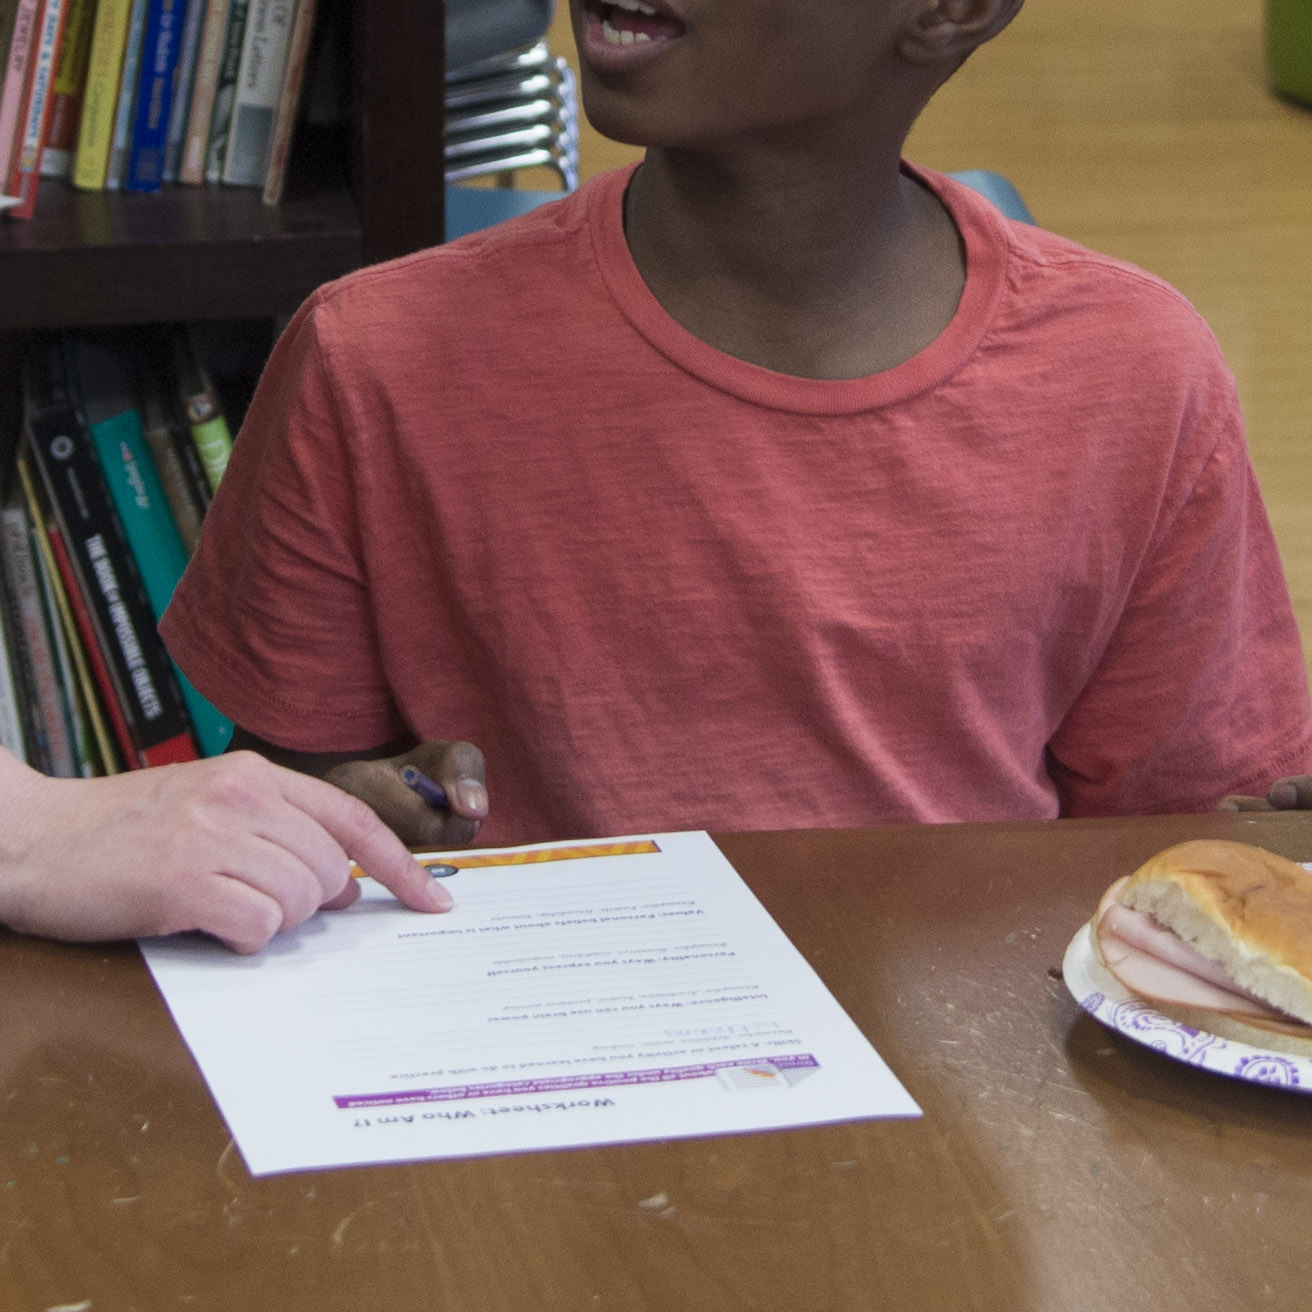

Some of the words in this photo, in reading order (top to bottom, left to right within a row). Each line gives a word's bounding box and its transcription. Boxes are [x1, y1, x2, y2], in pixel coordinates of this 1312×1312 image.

[479, 1097, 615, 1116] Worksheet:
[376, 1114, 416, 1125] Am
[421, 1109, 475, 1121] Who
[351, 1118, 372, 1127] I?
